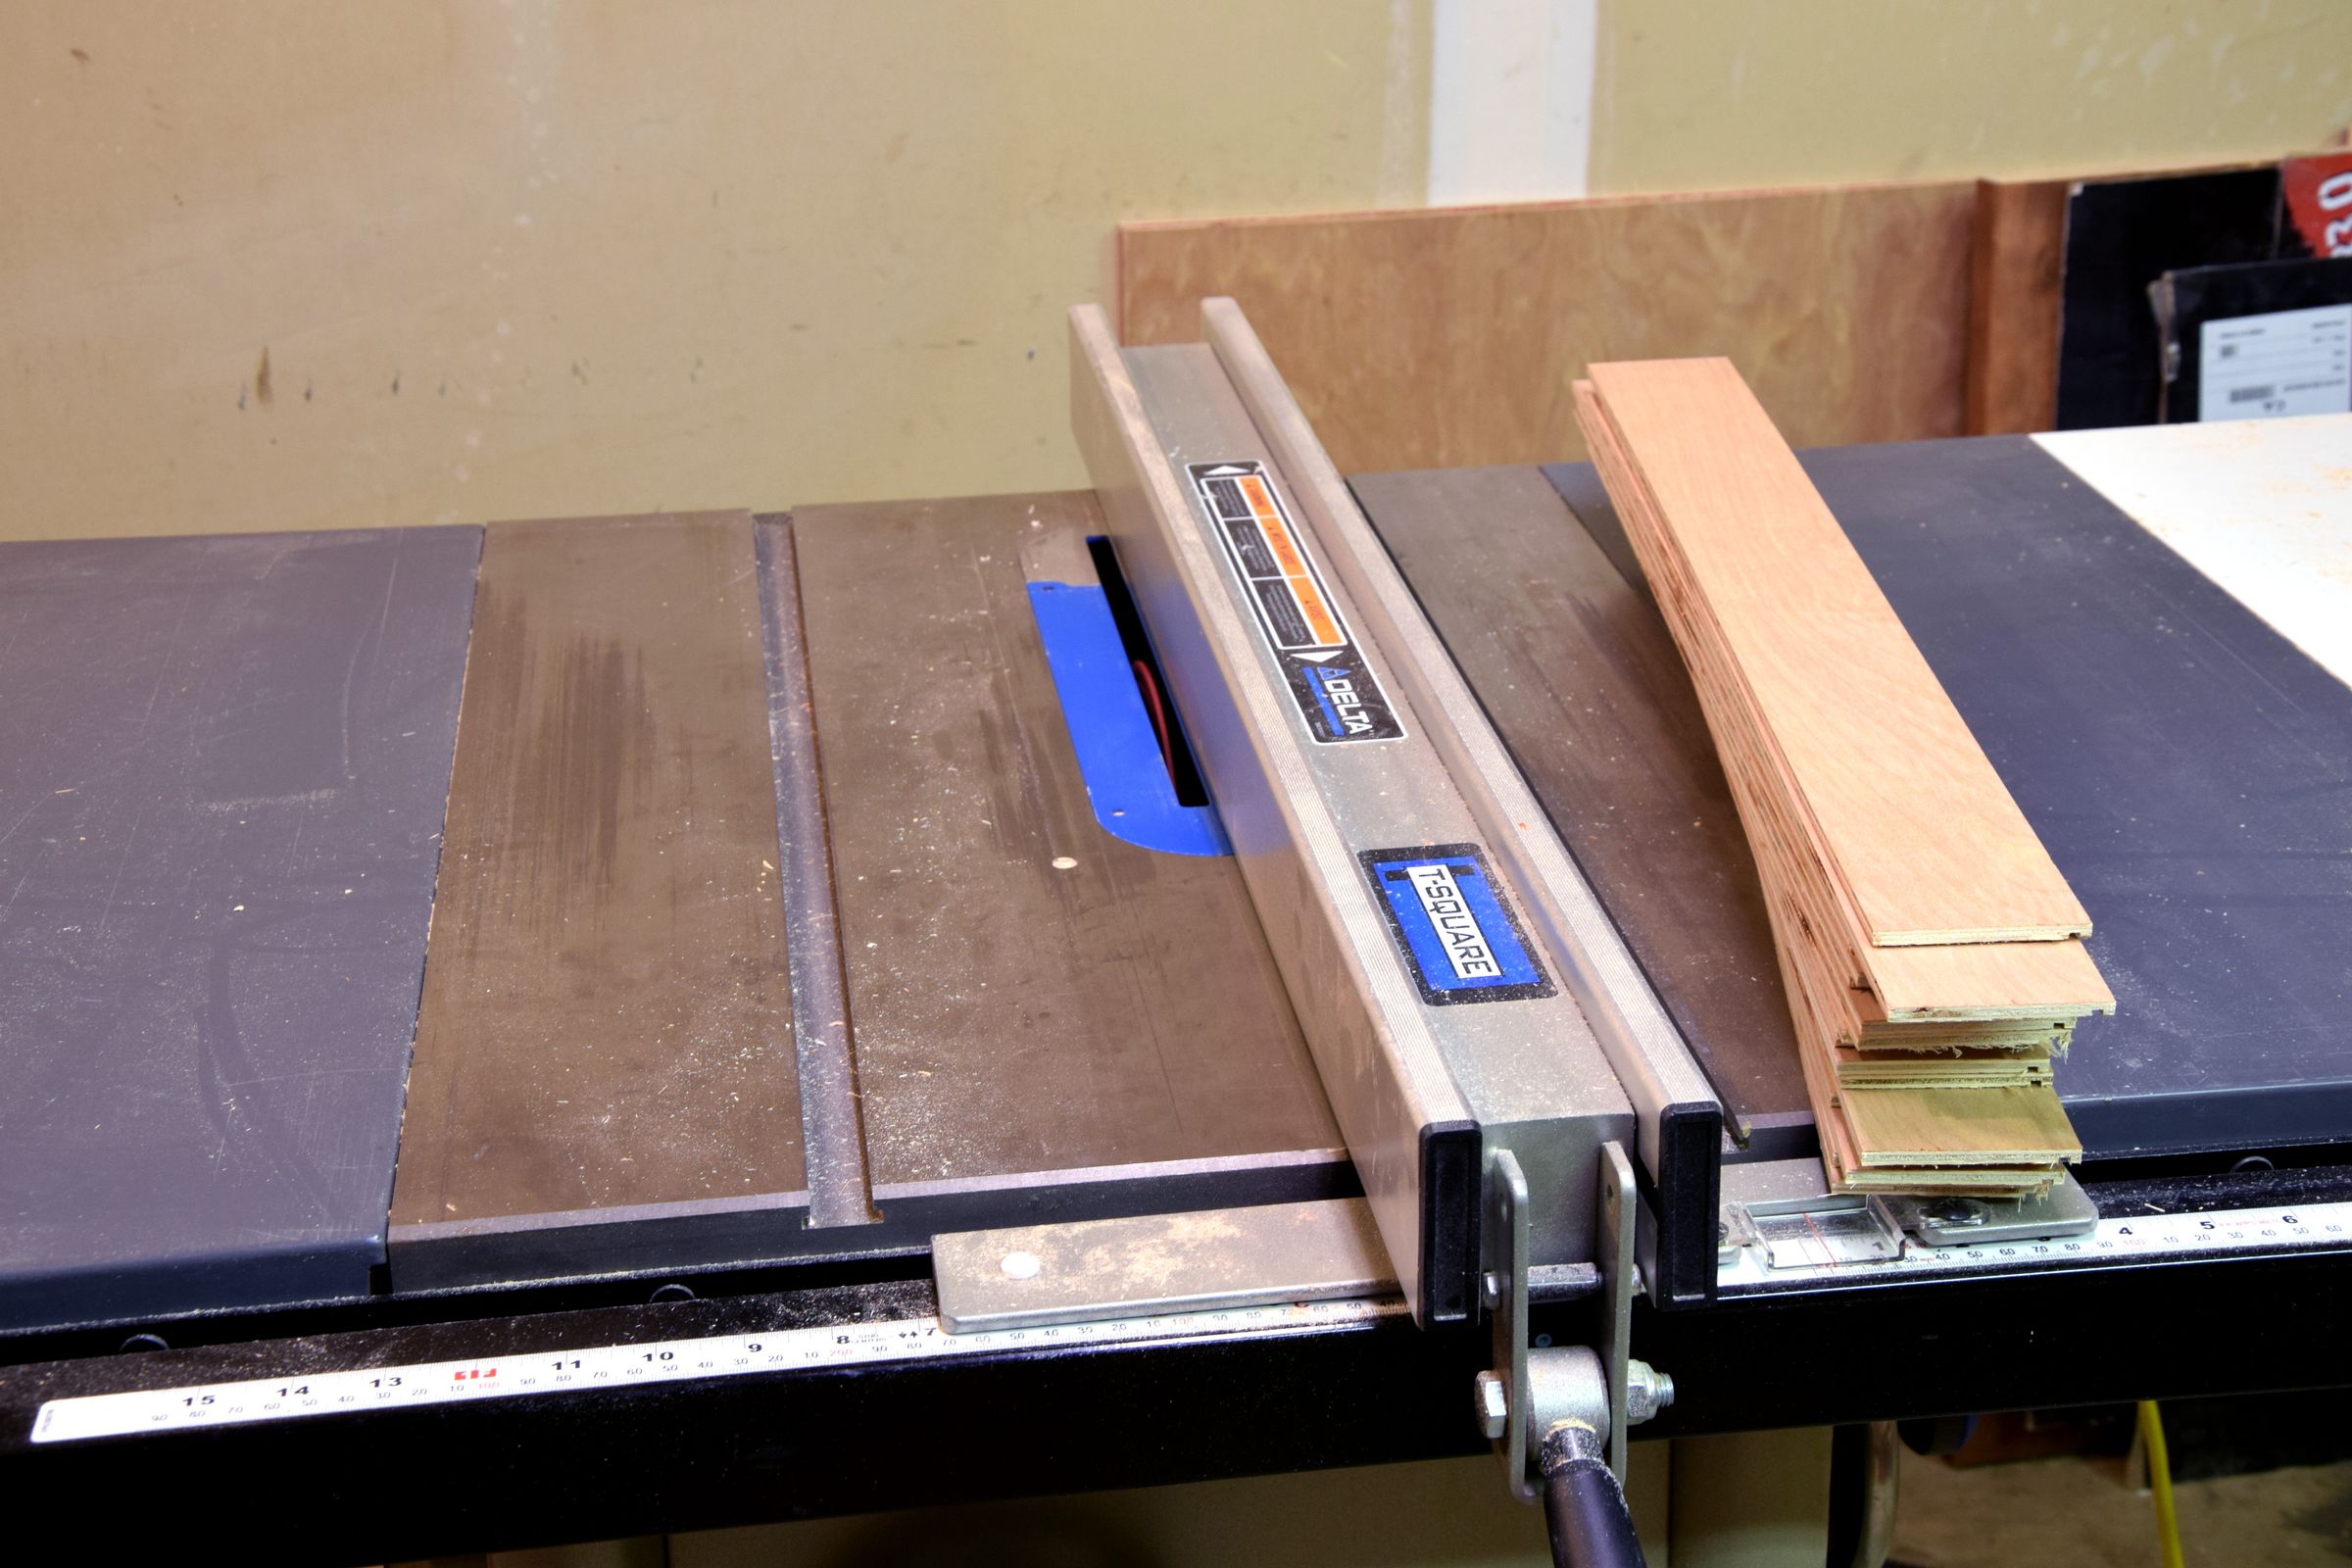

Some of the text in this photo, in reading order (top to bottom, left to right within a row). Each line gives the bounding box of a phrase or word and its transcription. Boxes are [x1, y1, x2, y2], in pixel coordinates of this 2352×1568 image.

[1324, 678, 1373, 734] DELTA
[1418, 867, 1494, 975] T-SQUARE
[1935, 1252, 1950, 1261] 40
[1967, 1250, 1983, 1259] 50
[2032, 1245, 2048, 1253] 70
[2064, 1243, 2081, 1251] 80
[2293, 1226, 2309, 1235] 50
[2119, 1227, 2132, 1236] 4
[2199, 1221, 2216, 1230] 5
[2281, 1215, 2298, 1224] 6
[593, 1370, 608, 1379] 70
[662, 1363, 678, 1372] 50
[698, 1360, 713, 1369] 40
[805, 1350, 818, 1359] 10
[1010, 1332, 1025, 1341] 50
[1147, 1319, 1161, 1328] 10
[1347, 1301, 1361, 1311] 50
[1380, 1298, 1396, 1307] 40
[182, 1395, 216, 1407] 15
[276, 1386, 310, 1397] 14
[369, 1377, 402, 1388] 13
[552, 1359, 581, 1371] 11
[642, 1351, 674, 1362] 10
[748, 1343, 762, 1352] 9
[836, 1335, 851, 1345] 8
